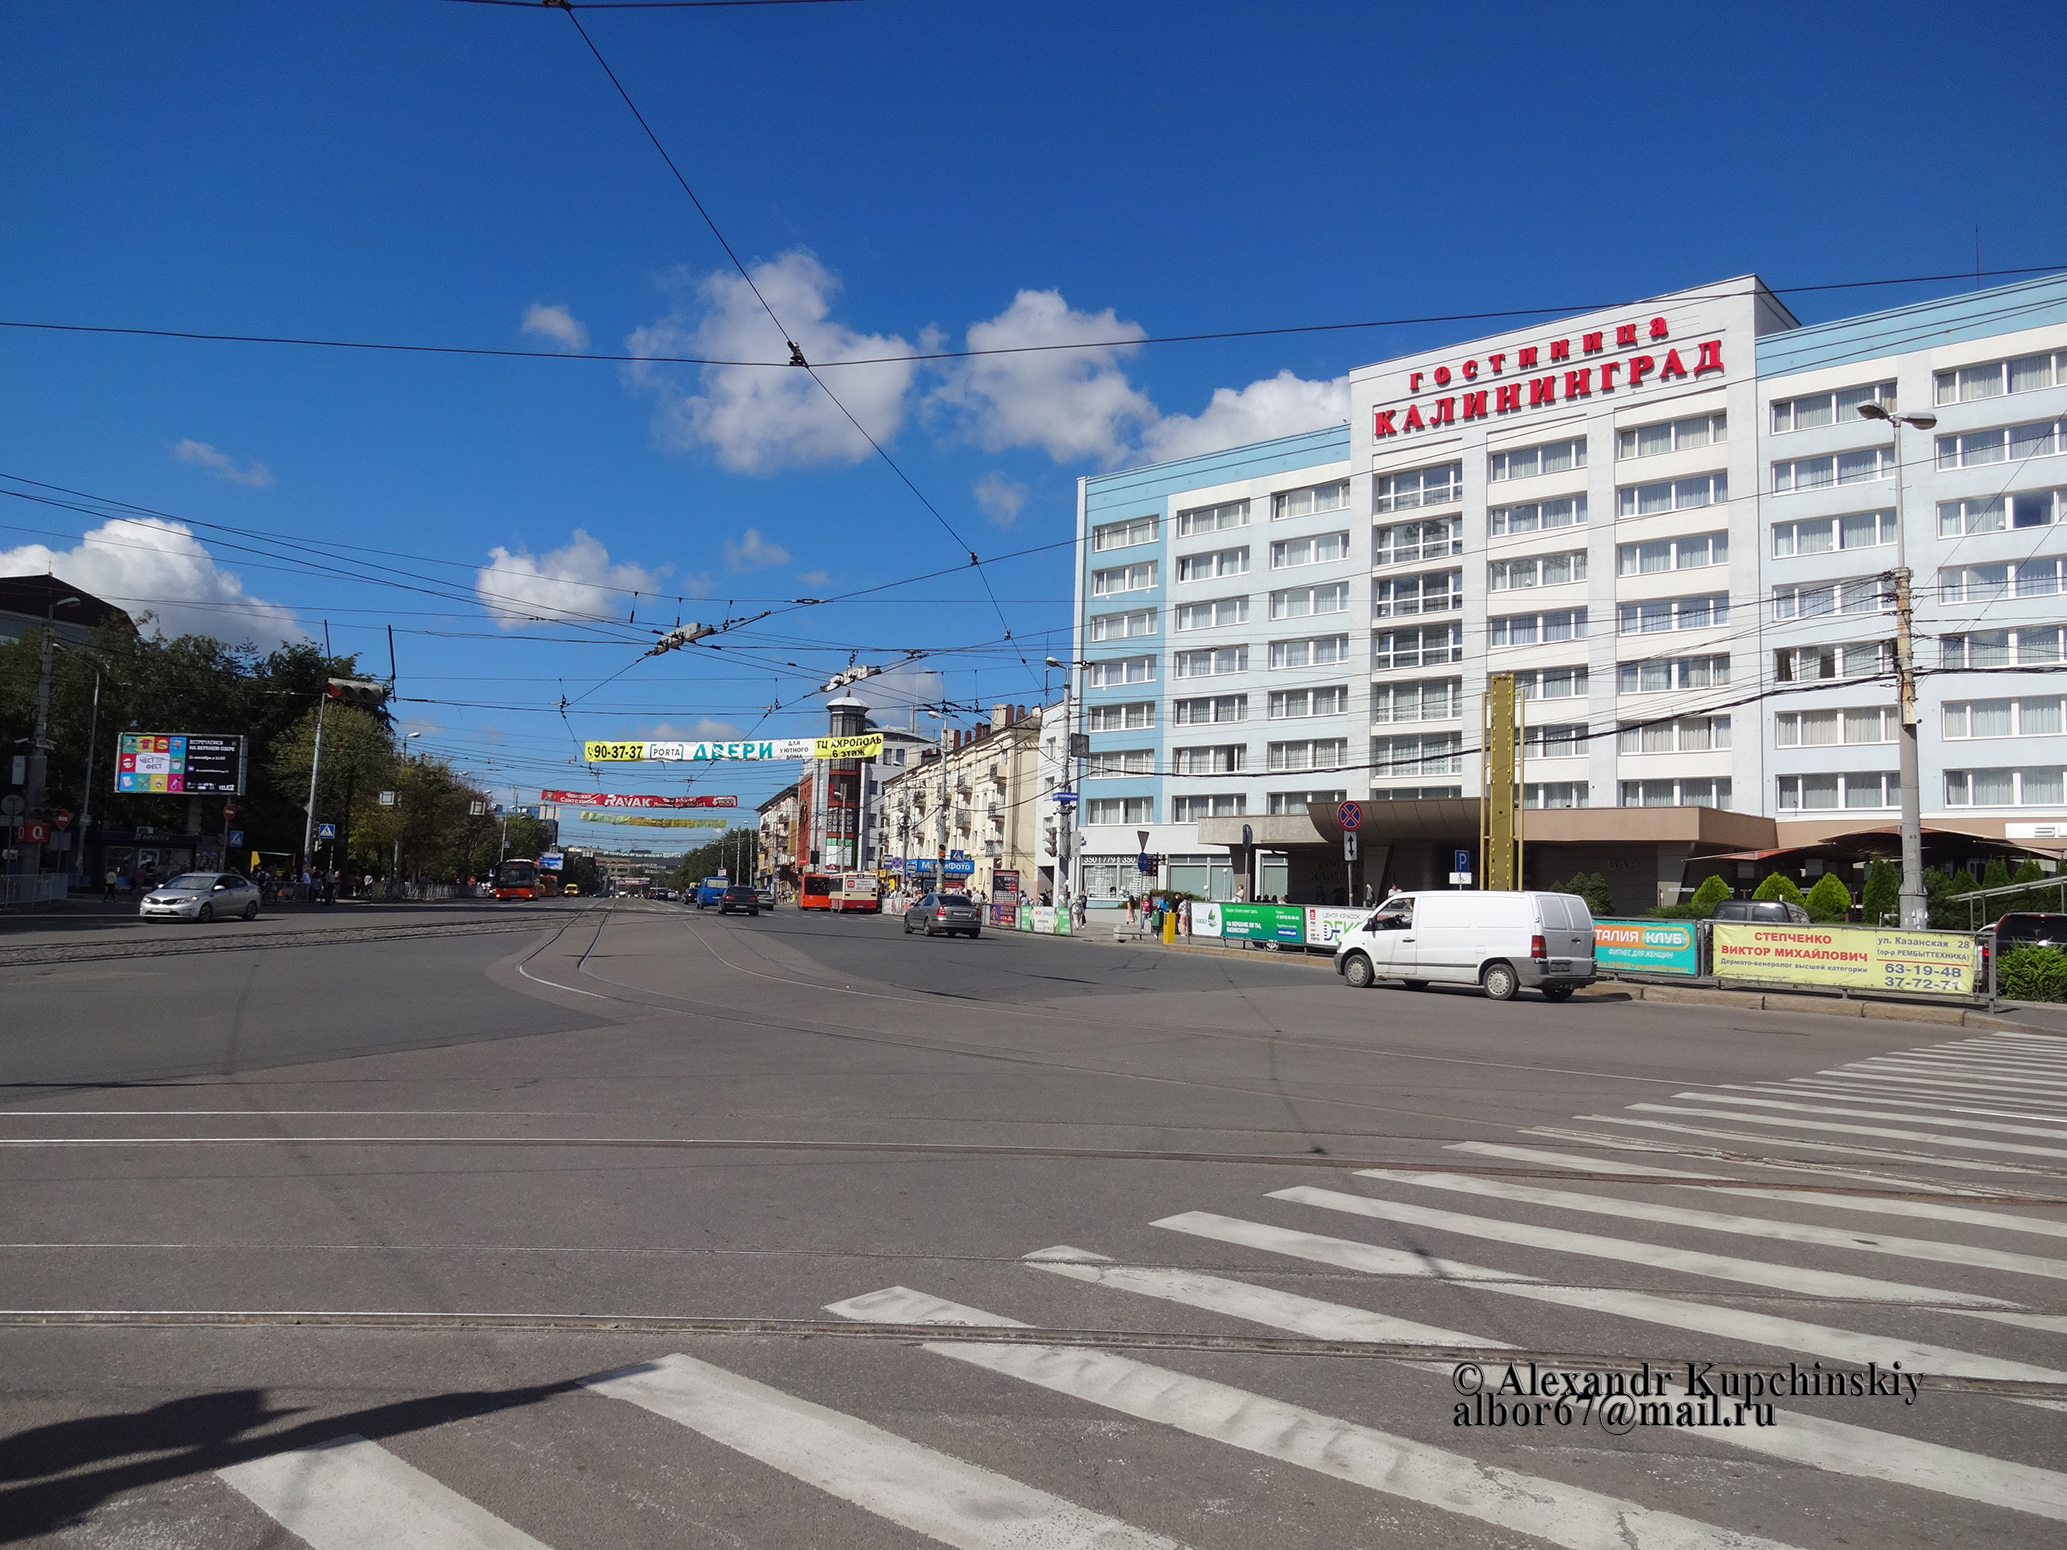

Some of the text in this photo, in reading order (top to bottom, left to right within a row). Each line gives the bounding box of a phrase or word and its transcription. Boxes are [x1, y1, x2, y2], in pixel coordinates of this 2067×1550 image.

[1374, 339, 1725, 438] КАЛИНИНГРАД
[693, 742, 773, 760] ДВЕРИ
[816, 740, 828, 749] ТЦ
[594, 745, 643, 759] 90-37-37
[653, 748, 681, 757] PORTA
[832, 748, 866, 758] 6 этаж
[604, 794, 651, 807] RAVAK
[1594, 929, 1682, 944] ТАЛИЯ КЛУБ
[1754, 932, 1832, 945] СТЕПЧЕНКО
[1877, 937, 1970, 949] ул. Казанская 28
[1608, 949, 1674, 959] ФИТНЕС ДЛЯ ЖЕНЩИН
[1721, 945, 1868, 962] ВИКТОР МИХАЙЛОВИЧ
[1897, 949, 1970, 960] РЕМБЫТТЕХНИКА)
[1720, 957, 1868, 973] Дермато-венеролог высшей категории
[1885, 963, 1962, 978] 63-19-48
[1884, 976, 1960, 991] 37-72-71
